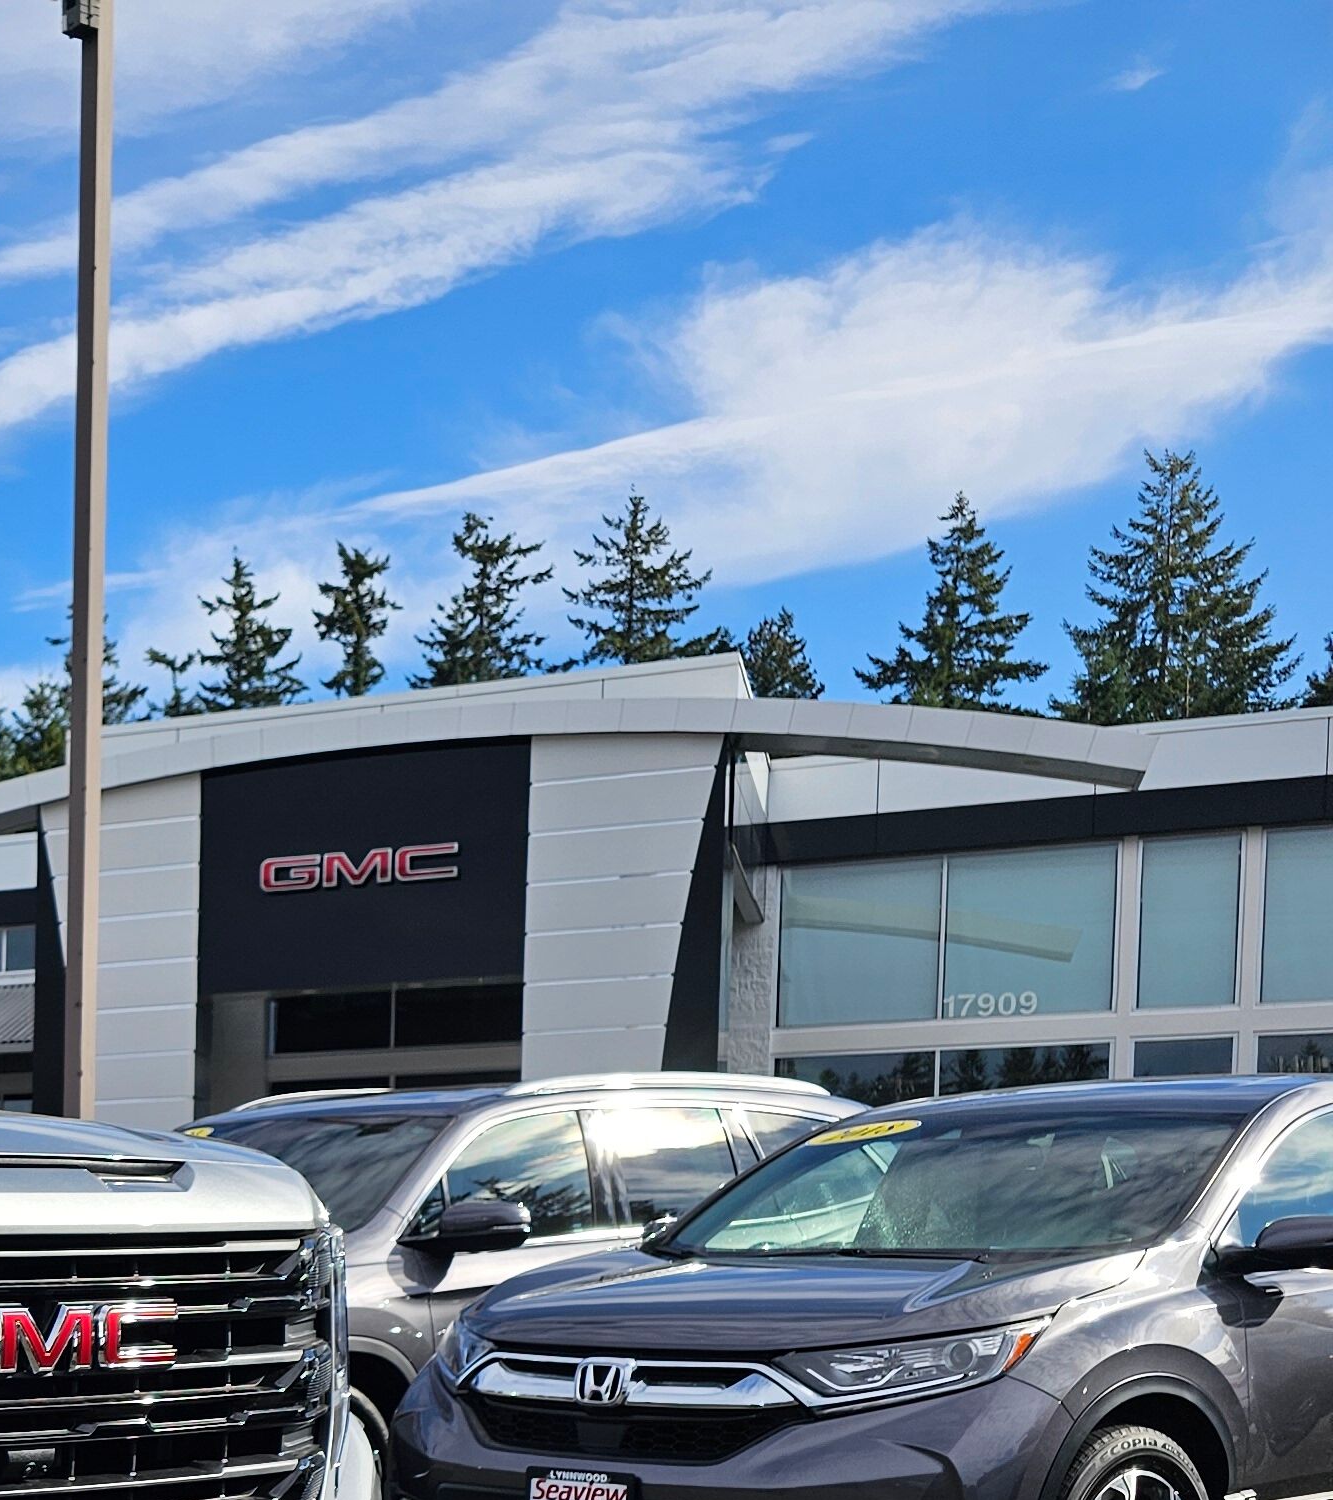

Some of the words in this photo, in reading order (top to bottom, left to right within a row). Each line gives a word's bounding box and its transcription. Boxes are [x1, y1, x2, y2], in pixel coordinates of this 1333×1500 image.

[260, 842, 459, 892] GMC
[944, 991, 1038, 1018] 17909
[549, 1470, 608, 1483] LYNNWOOD
